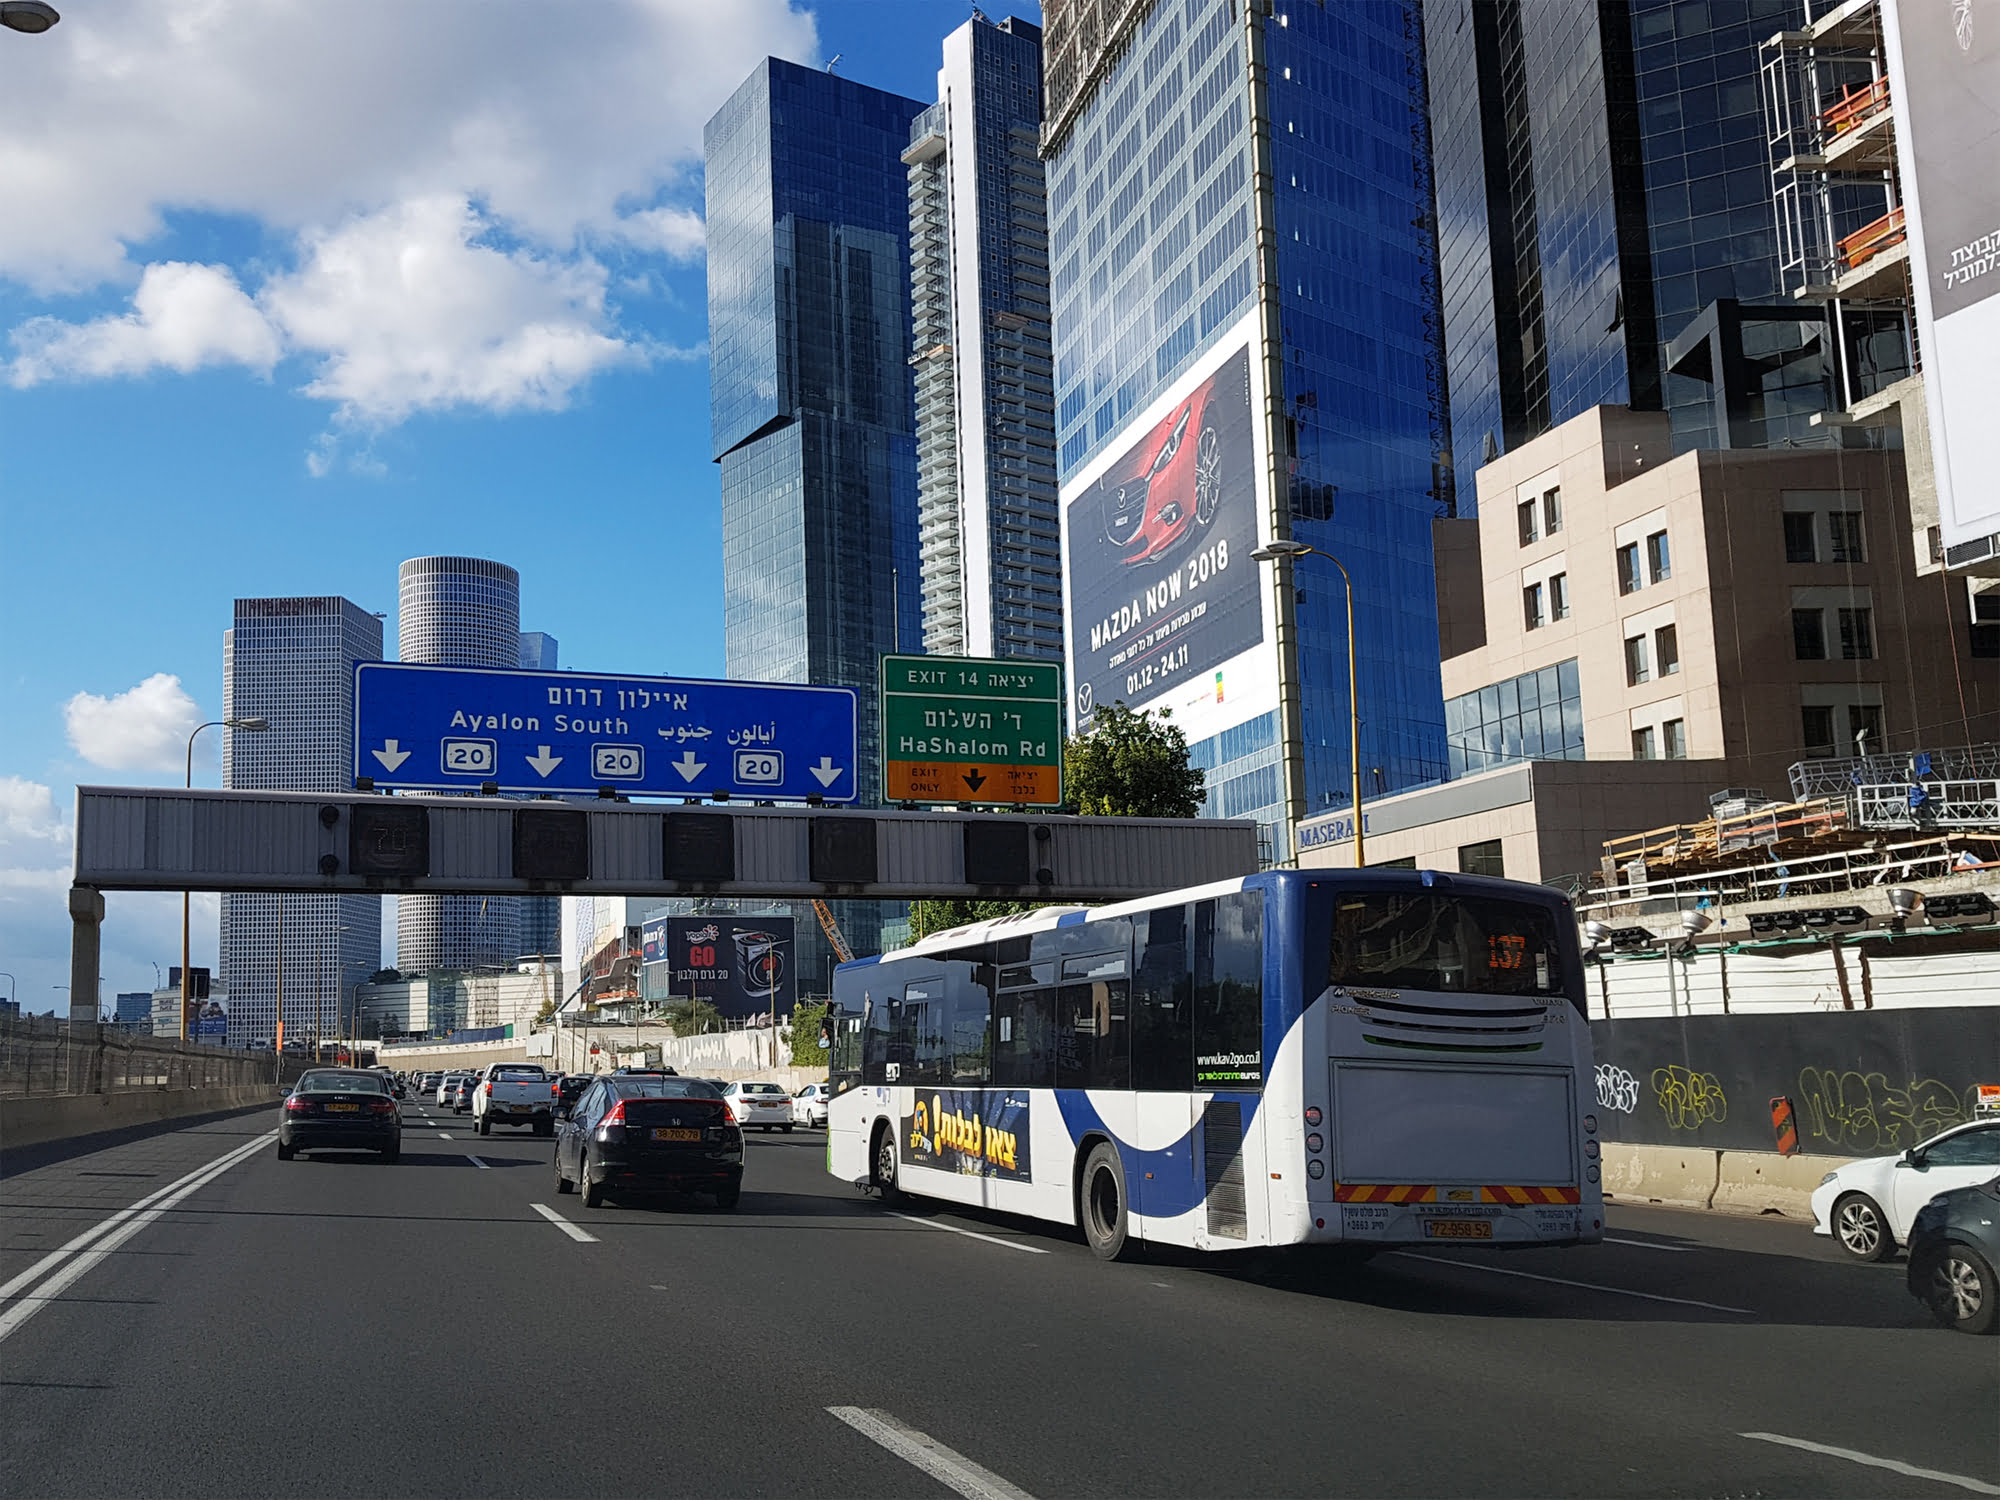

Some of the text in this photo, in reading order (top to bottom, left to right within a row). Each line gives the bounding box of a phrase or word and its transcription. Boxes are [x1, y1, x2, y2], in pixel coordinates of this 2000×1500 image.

[1943, 251, 2000, 289] למוביל
[1091, 539, 1229, 652] MAZDA NOW 2018
[908, 670, 979, 686] EXIT 14
[988, 674, 1034, 688] יציאה
[548, 686, 688, 711] איילון דרום
[450, 710, 629, 735] Ayalon South
[925, 709, 992, 729] השלום
[657, 722, 776, 746] أيالون جنوب
[455, 748, 484, 765] 20
[900, 736, 1046, 757] HaShalom Rd
[604, 754, 633, 770] 20
[745, 760, 773, 776] 20
[911, 768, 939, 777] EXIT
[1008, 771, 1038, 780] יציאה
[911, 783, 939, 792] ONLY
[1011, 785, 1036, 795] בלבד
[1300, 814, 1370, 848] MASERAI
[690, 946, 715, 967] GO
[1488, 935, 1525, 969] 137
[677, 968, 729, 982] 20 גרם חלבון
[932, 1094, 1017, 1170] צאו לבלות!
